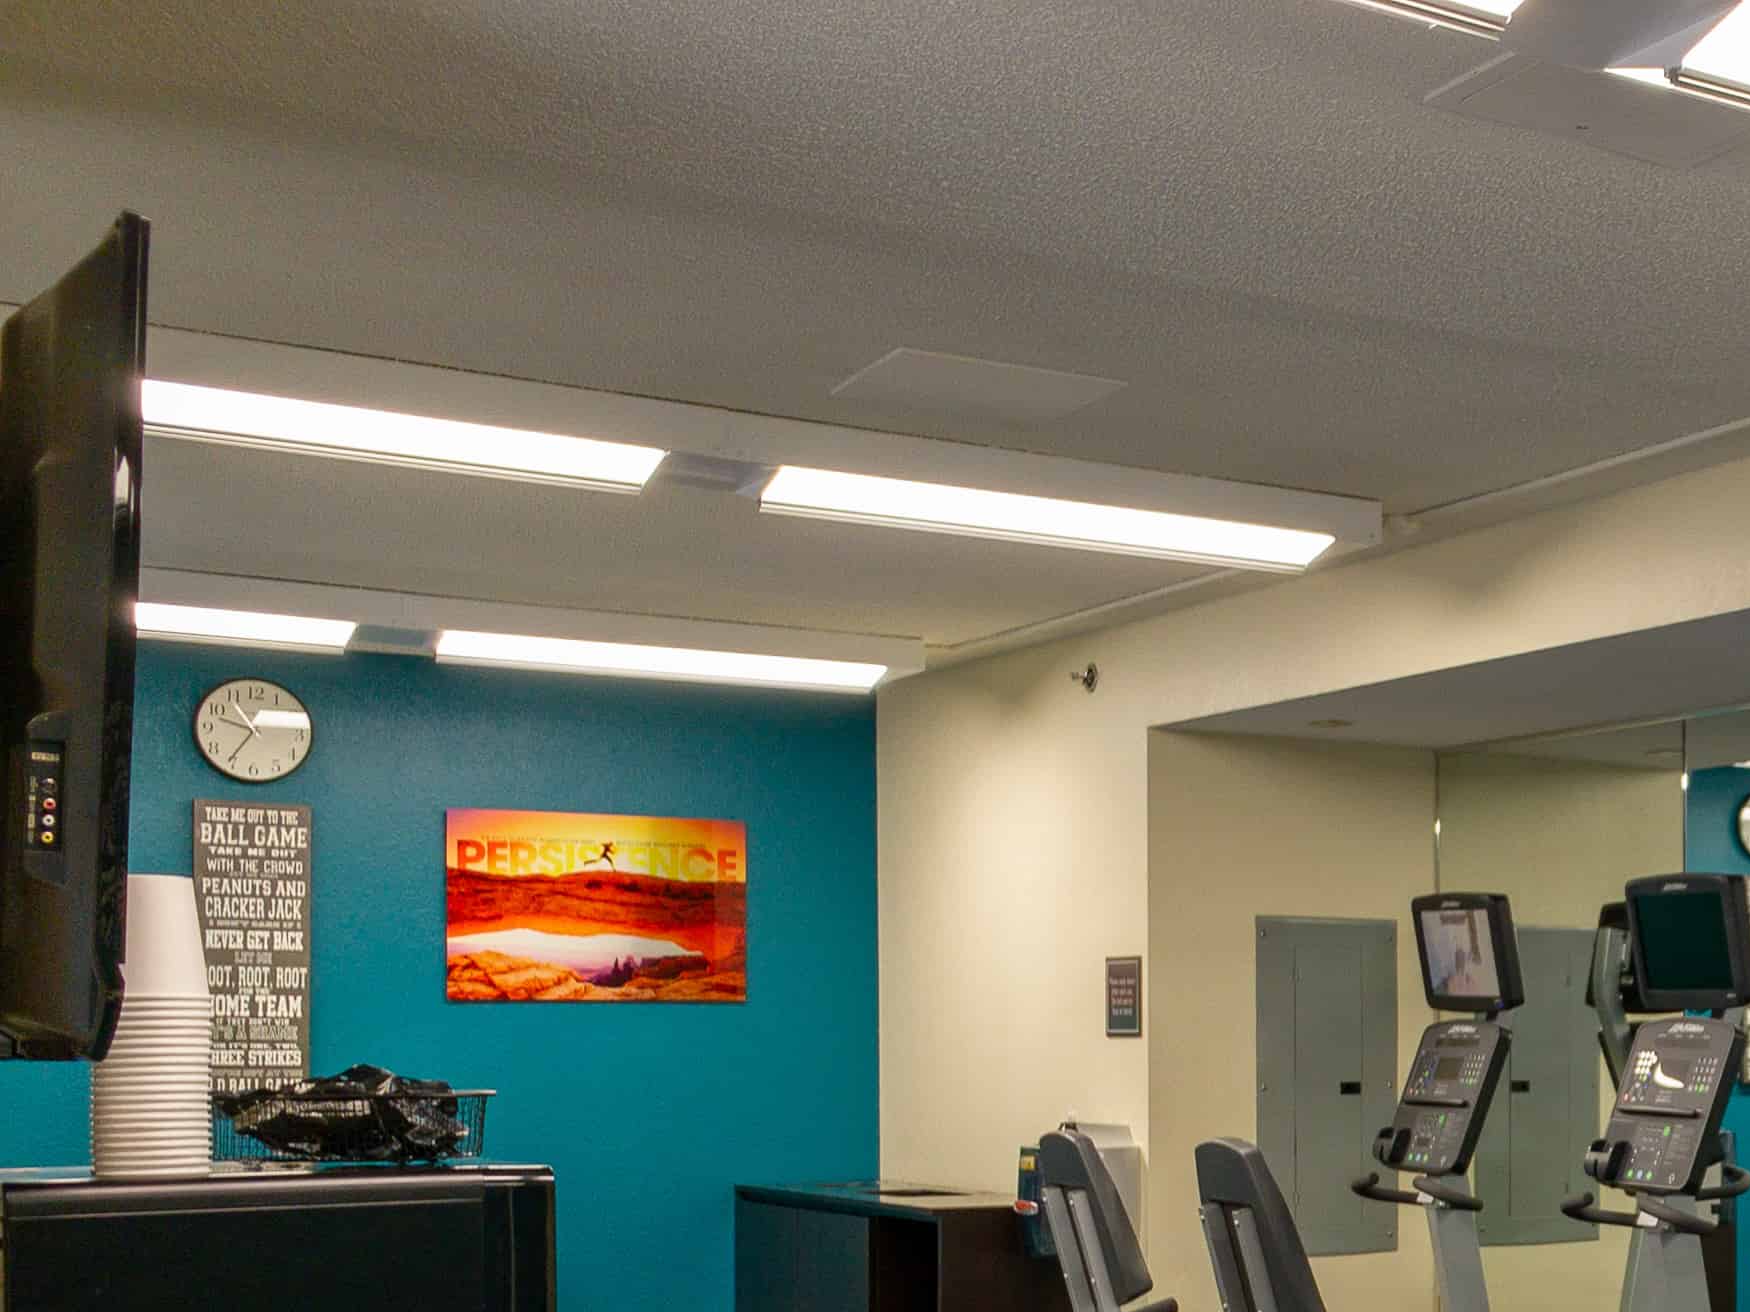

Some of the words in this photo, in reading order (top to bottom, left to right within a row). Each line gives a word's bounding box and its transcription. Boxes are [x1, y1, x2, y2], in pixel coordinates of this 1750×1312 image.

[227, 690, 240, 703] 11
[248, 686, 265, 700] 12
[210, 703, 225, 716] 10
[205, 806, 229, 822] TAKE
[231, 808, 246, 822] ME
[247, 808, 265, 824] OUT
[266, 810, 278, 825] TO
[280, 811, 299, 826] THE
[200, 822, 249, 845] BALL
[254, 825, 308, 849] GAME
[208, 846, 242, 857] TAKE
[247, 847, 266, 857] ME
[271, 848, 297, 859] OUT
[457, 839, 737, 881] PERSISENCE
[206, 858, 234, 873] WITH
[239, 859, 259, 873] THE
[263, 860, 304, 875] CROWD
[202, 877, 272, 896] PEANUTS
[276, 880, 306, 897] AND
[205, 896, 265, 919] CRACKER
[268, 898, 303, 920] JACK
[205, 929, 244, 950] NEVER
[246, 929, 270, 950] GET
[273, 931, 304, 952] BACK
[208, 966, 236, 989] OOT,
[238, 967, 273, 990] ROOT,
[276, 967, 308, 990] ROOT
[255, 995, 303, 1018] TEAM
[210, 1050, 245, 1066] HREE
[248, 1050, 302, 1067] STRIKES
